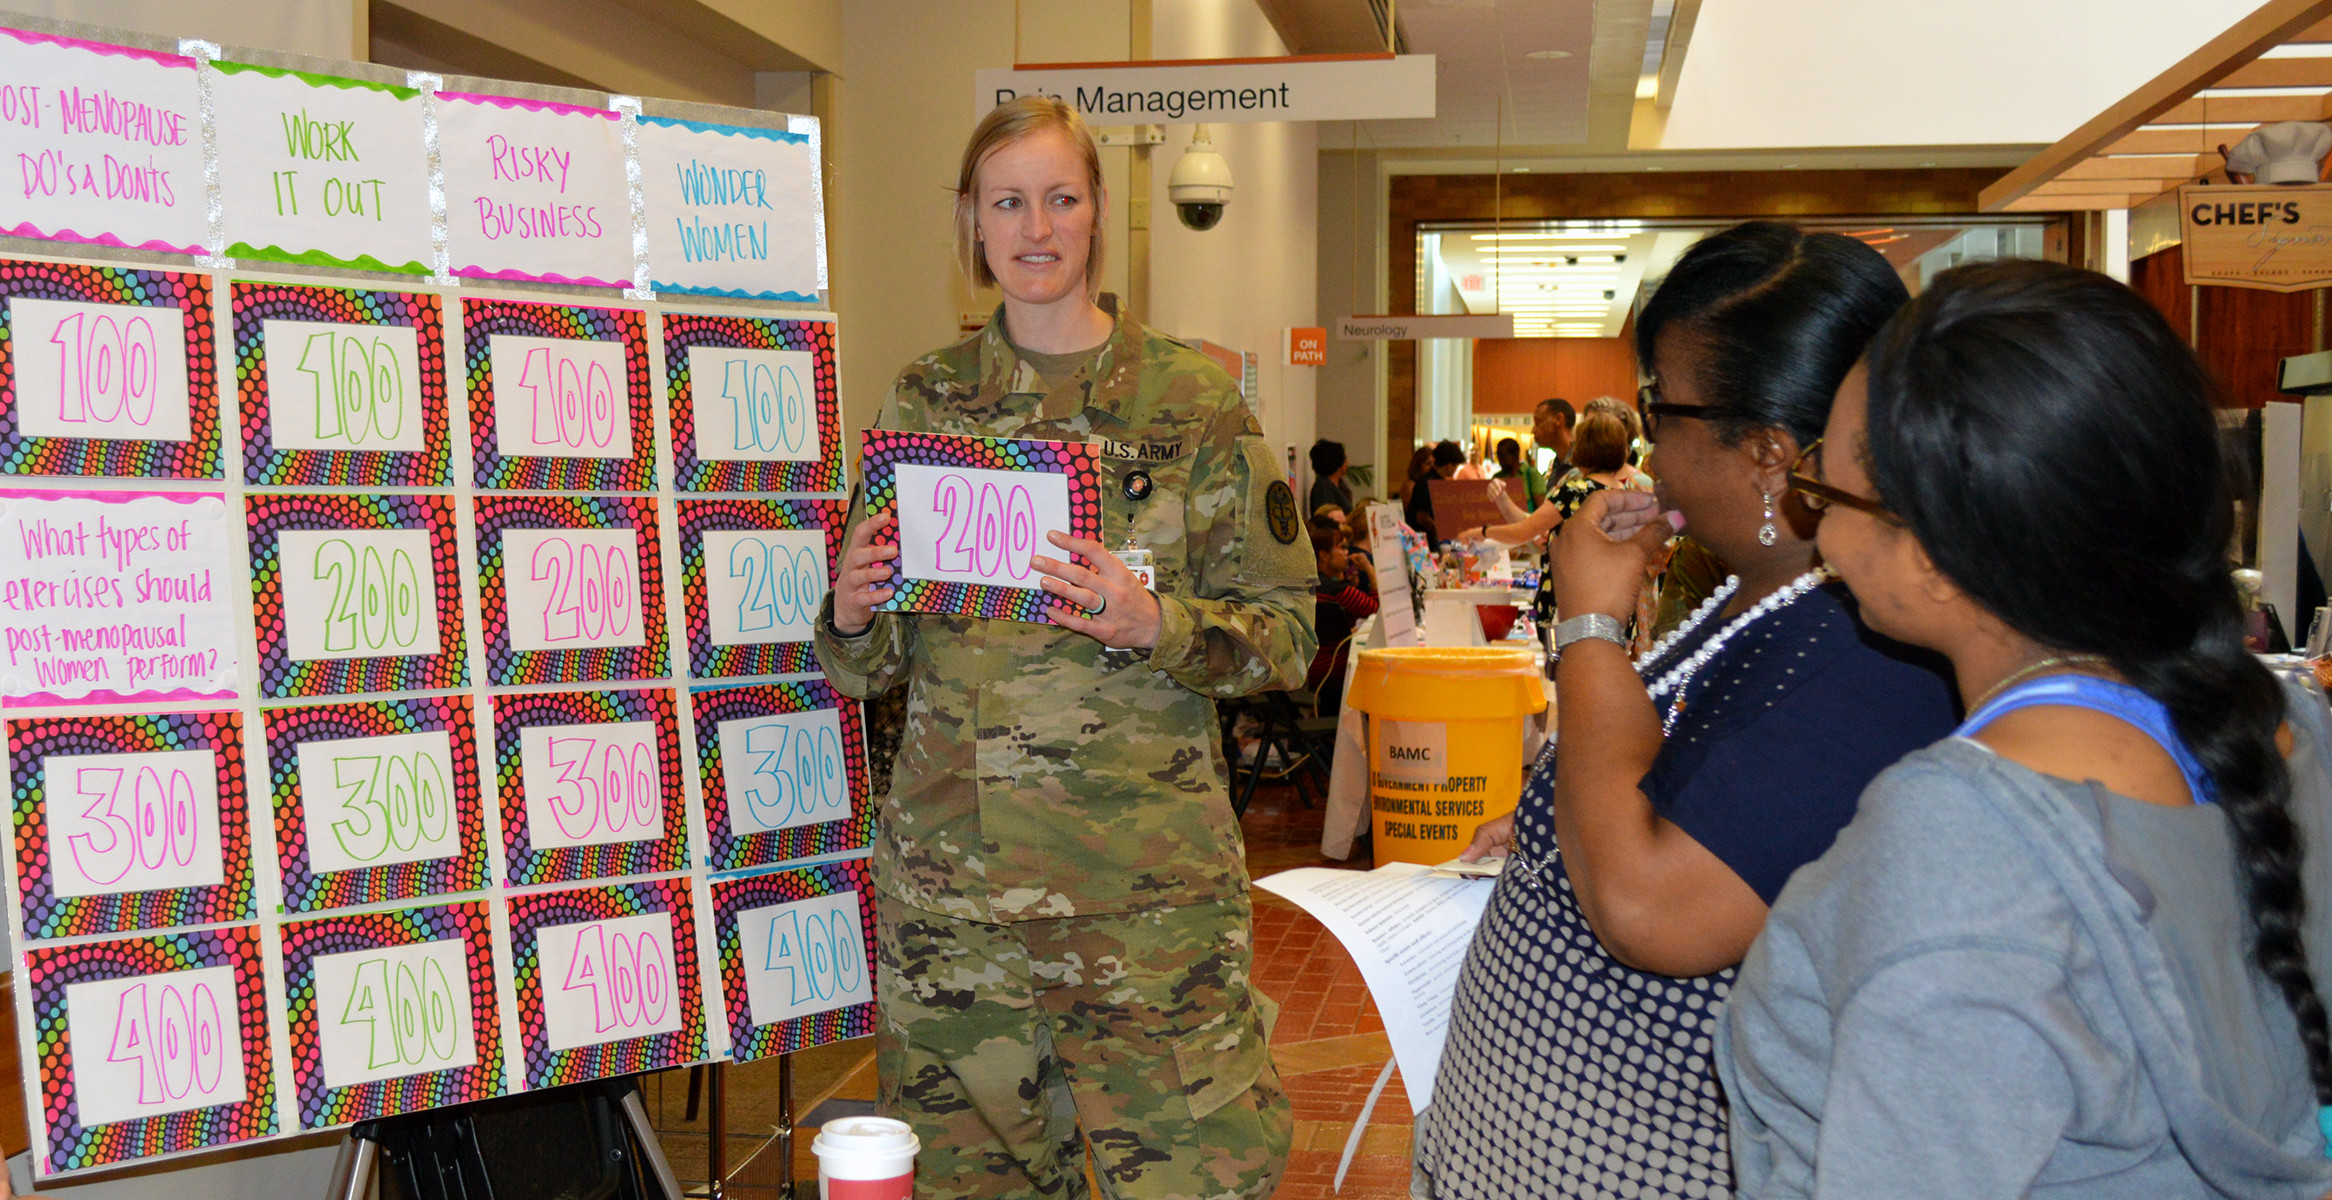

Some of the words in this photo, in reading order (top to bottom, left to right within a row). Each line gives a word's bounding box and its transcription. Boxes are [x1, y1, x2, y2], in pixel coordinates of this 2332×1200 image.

[1076, 81, 1290, 118] Management
[282, 108, 360, 162] WORK
[486, 134, 570, 194] RISKY
[273, 171, 298, 216] IT
[323, 177, 386, 222] OUT
[676, 160, 774, 211] WONDER
[2190, 201, 2301, 226] CHEF'S
[474, 197, 602, 241] BUSINESS
[676, 215, 768, 263] WOMEN
[1293, 351, 1323, 362] PATH
[1299, 339, 1318, 350] ON
[1344, 325, 1408, 339] Neurology
[49, 311, 158, 426] 100
[297, 331, 403, 446] 100
[518, 347, 616, 449] 100
[721, 359, 806, 453] 100
[19, 518, 89, 561] What
[95, 515, 161, 573] types
[166, 519, 192, 552] of
[932, 473, 1036, 580] 200
[5, 569, 124, 613] exercises
[135, 567, 212, 605] should
[313, 538, 420, 652] 200
[530, 537, 632, 643] 200
[729, 537, 823, 633] 200
[126, 648, 218, 689] perform?
[744, 724, 844, 829] 300
[1389, 745, 1431, 760] BAMC
[331, 751, 450, 861] 300
[547, 735, 658, 840] 300
[1435, 799, 1485, 816] SERVICES
[67, 765, 198, 886] 300
[1385, 820, 1417, 839] SPECIAL
[1420, 824, 1458, 841] EVENTS
[562, 924, 669, 1034] 400
[764, 908, 861, 1007] 400
[340, 956, 458, 1070] 400
[107, 982, 223, 1105] 400
